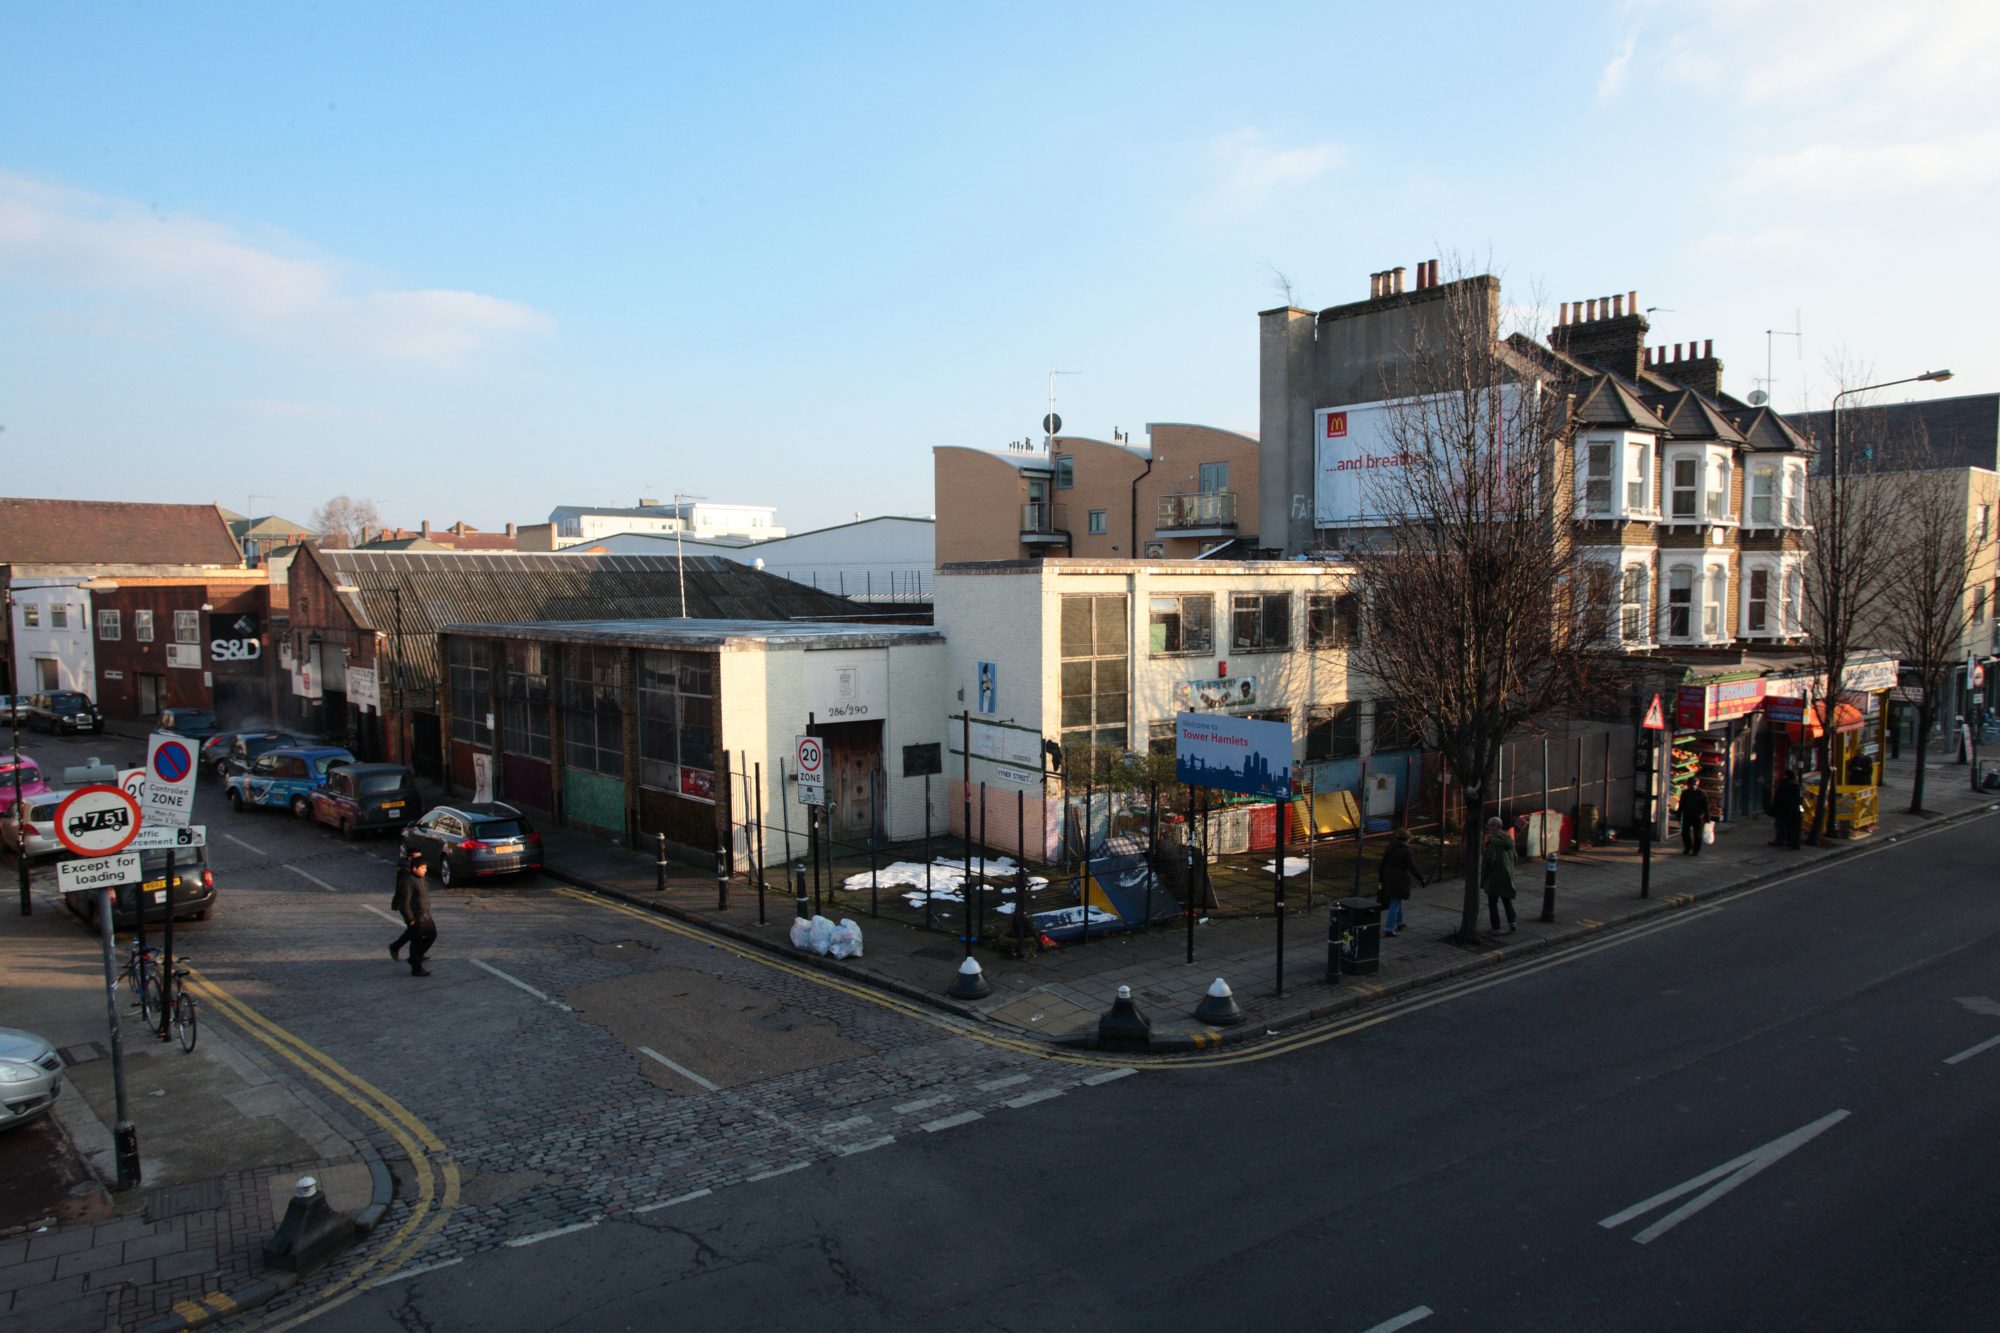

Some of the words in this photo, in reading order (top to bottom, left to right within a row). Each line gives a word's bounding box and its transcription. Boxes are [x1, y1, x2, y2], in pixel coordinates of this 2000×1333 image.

[1326, 456, 1362, 472] ...and
[211, 638, 260, 662] S&D
[828, 704, 868, 717] 286/290
[1183, 720, 1210, 730] Welcome
[1184, 729, 1209, 741] Tower
[1211, 733, 1249, 747] Hamlets
[802, 748, 818, 762] 20
[800, 772, 821, 783] ZONE
[150, 784, 188, 796] Controlled
[152, 793, 184, 807] ZONE
[87, 808, 126, 828] 7.5T
[61, 860, 110, 874] Except
[116, 856, 136, 867] for
[76, 870, 125, 885] loading
